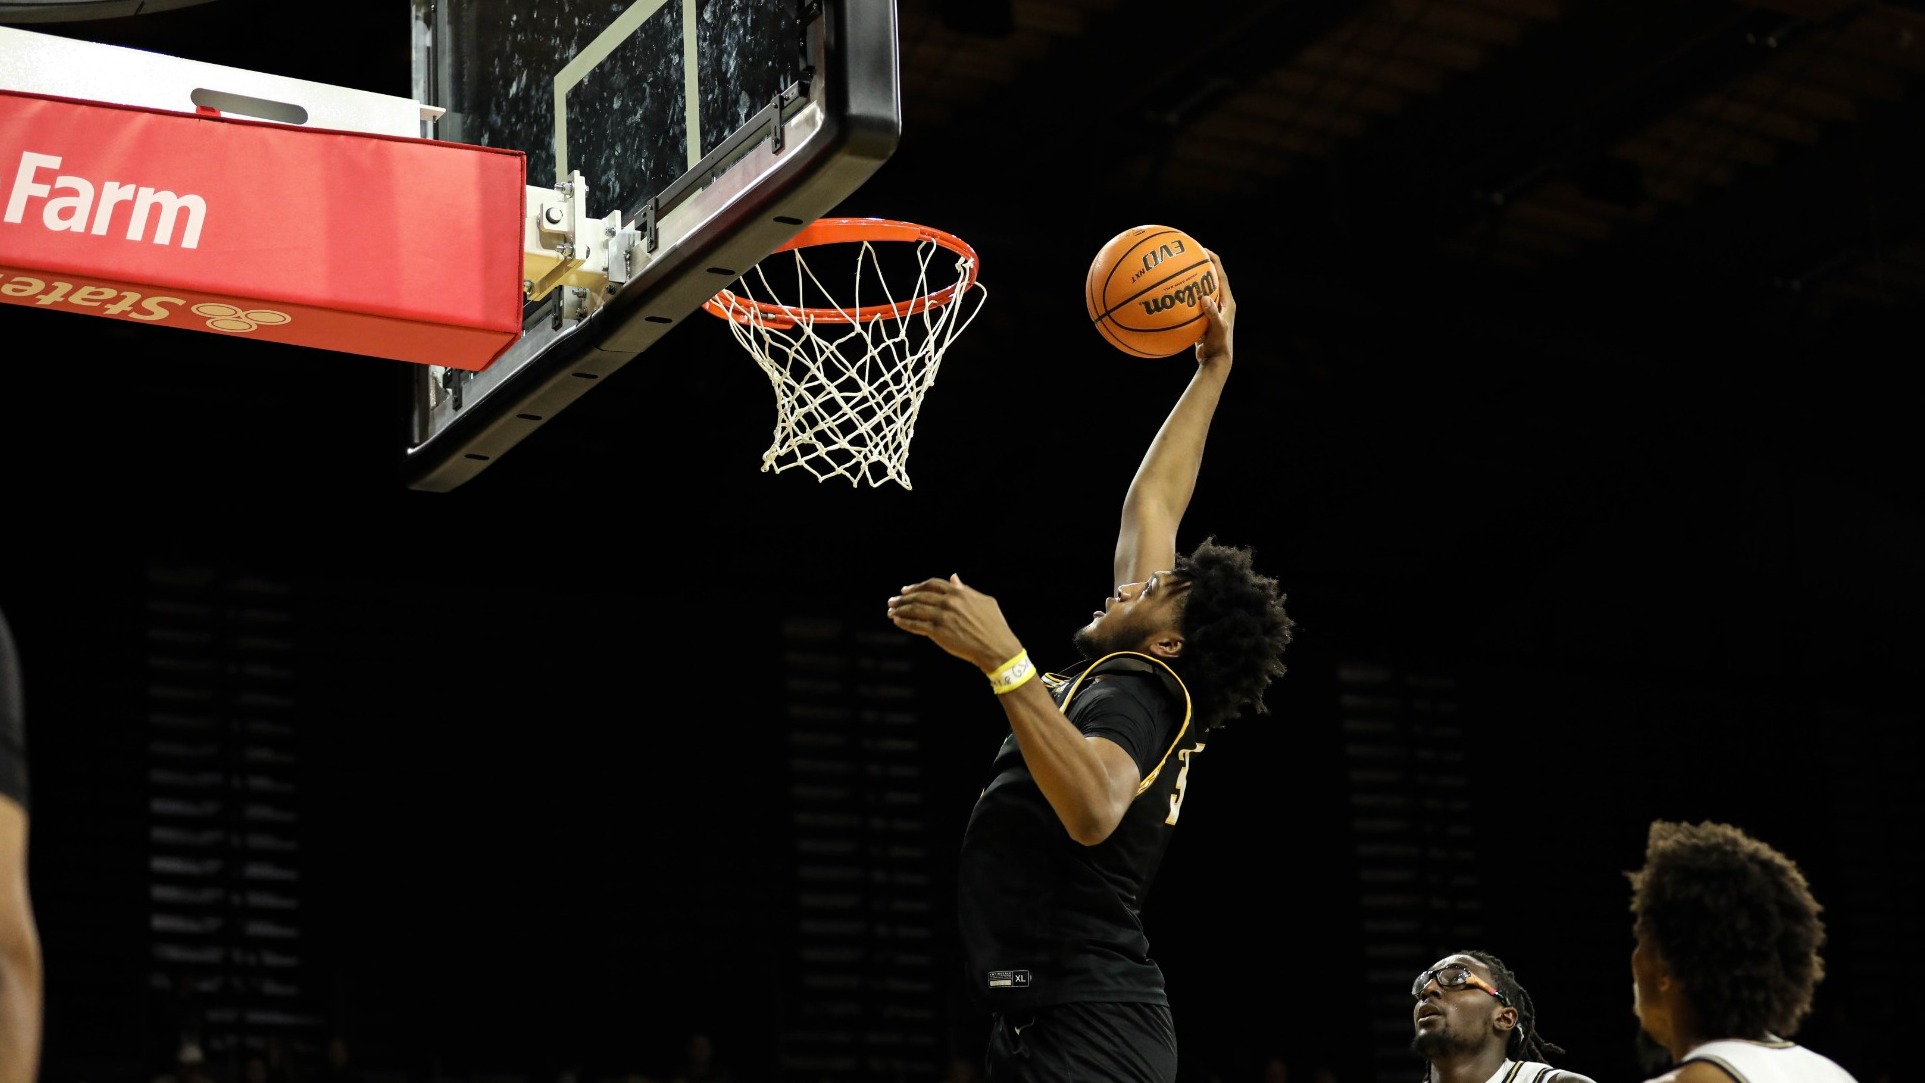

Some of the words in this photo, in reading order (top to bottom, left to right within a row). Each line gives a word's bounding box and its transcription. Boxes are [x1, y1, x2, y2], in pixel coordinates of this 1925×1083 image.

[3, 151, 207, 249] Farm
[1131, 267, 1147, 284] NXT
[1142, 270, 1217, 315] Wilson
[1, 276, 187, 321] State
[1015, 974, 1026, 983] XL
